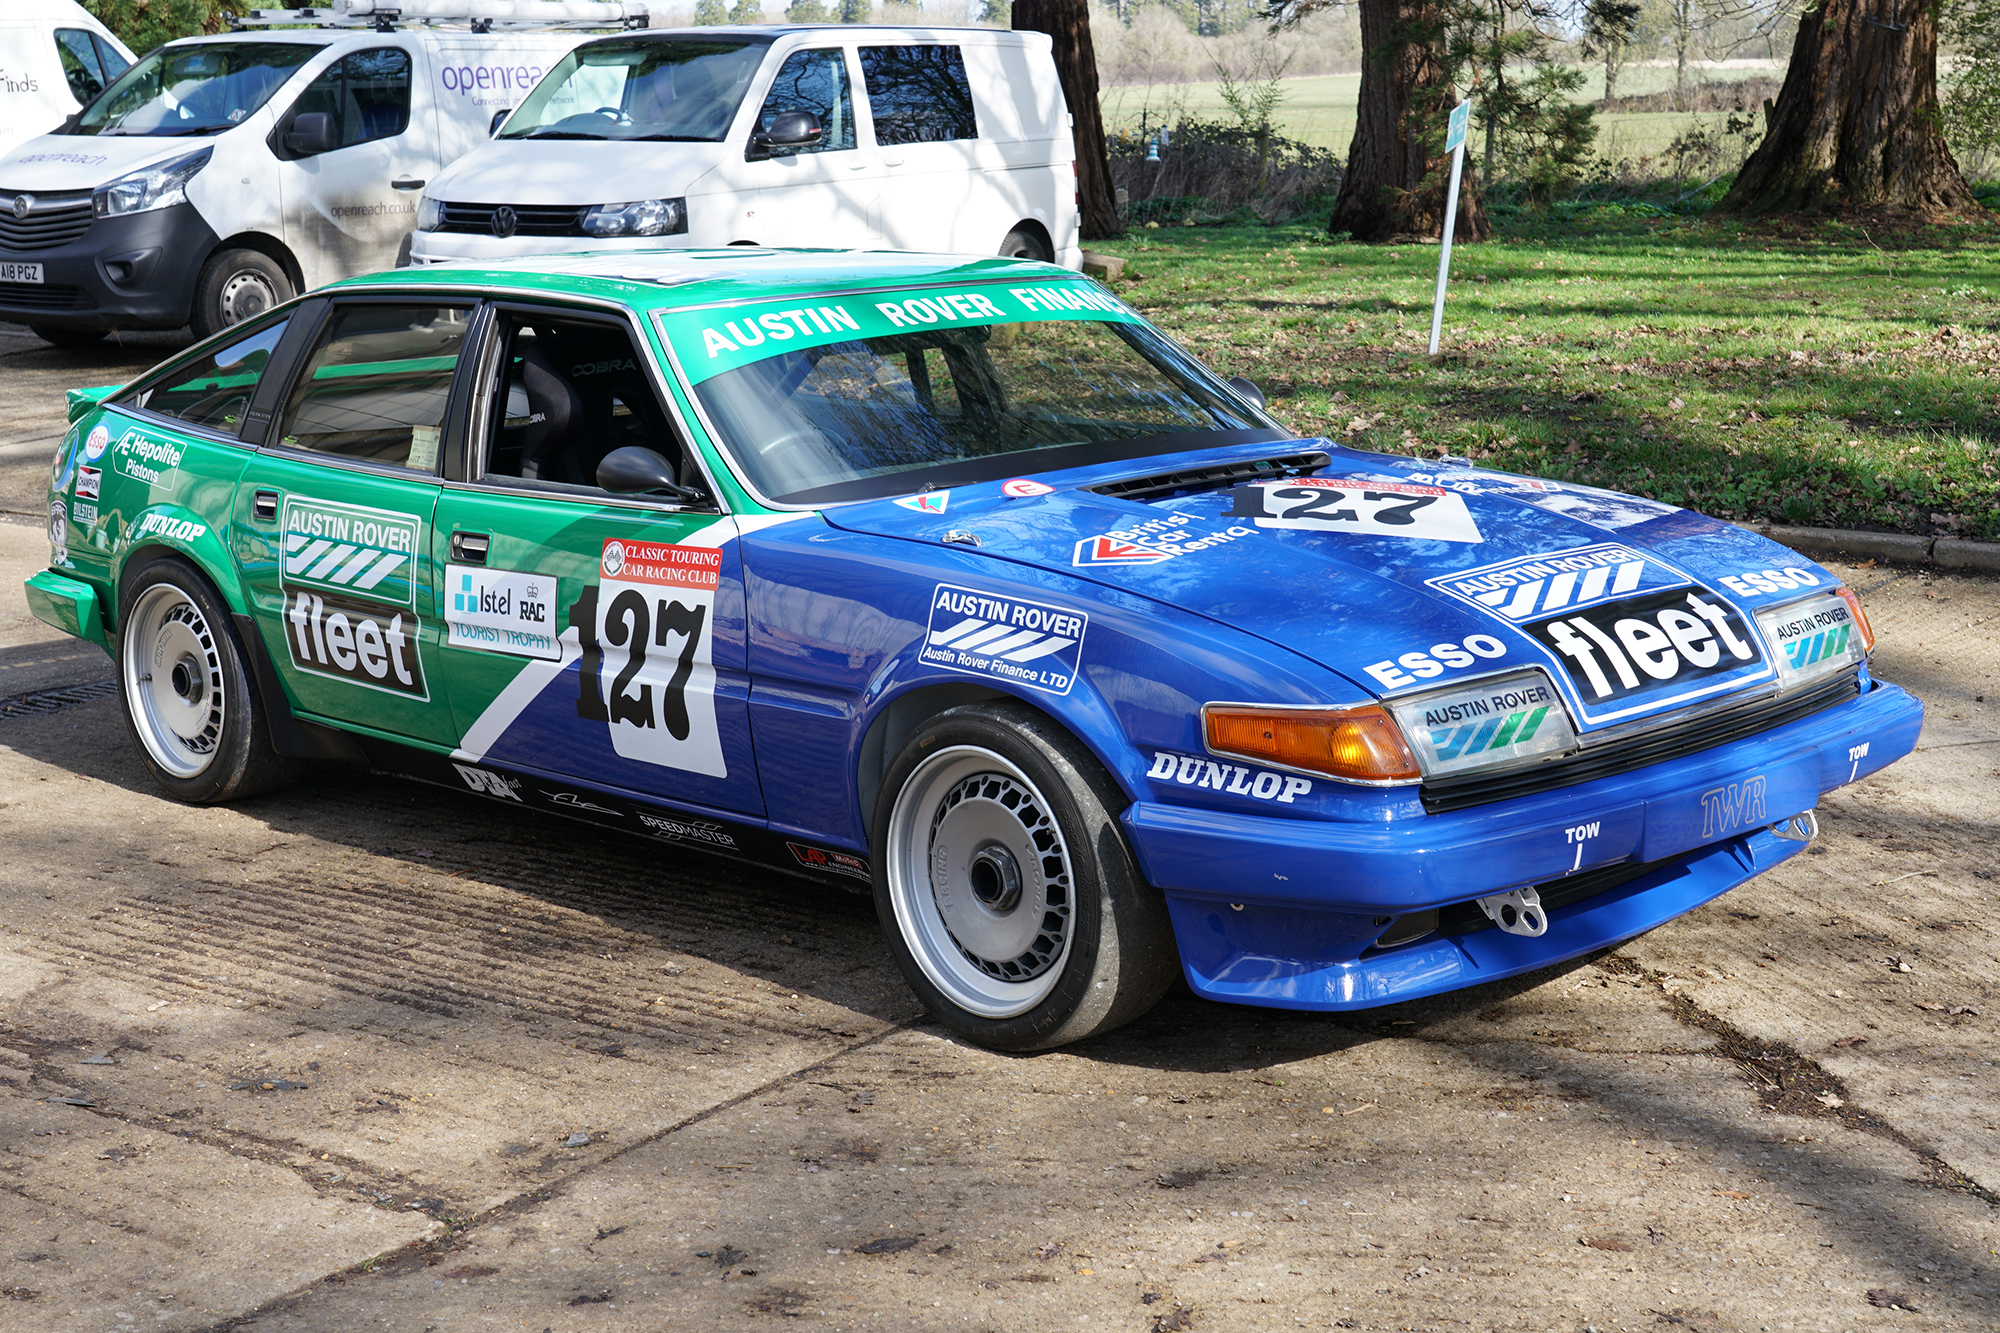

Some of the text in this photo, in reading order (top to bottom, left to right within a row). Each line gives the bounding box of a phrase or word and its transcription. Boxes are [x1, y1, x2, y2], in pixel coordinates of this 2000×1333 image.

[442, 64, 573, 95] openrea
[472, 96, 510, 107] Connecting
[19, 151, 108, 166] openreach
[330, 200, 416, 219] openreach.co.uk
[17, 265, 38, 280] PGZ
[702, 305, 860, 359] AUSTIN
[875, 293, 1007, 327] ROVER
[572, 358, 638, 377] COBRA
[131, 435, 180, 467] Hepolite
[78, 476, 99, 489] CHAMPION
[125, 458, 159, 483] Pistons
[73, 501, 98, 519] BILSTEIN
[1217, 485, 1438, 525] 127
[139, 513, 206, 542] DUNLOP
[288, 510, 411, 552] AUSTIN ROVER
[1135, 529, 1192, 549] Car
[625, 545, 668, 561] CLASSIC
[670, 550, 719, 566] TOURING
[623, 563, 717, 584] CAR RACING CLUB
[1456, 546, 1642, 598] AUSTIN ROVER
[1717, 566, 1820, 598] ESSO
[480, 585, 511, 615] Istel
[519, 601, 545, 622] RAC
[936, 591, 1081, 638] AUSTIN ROVER
[290, 591, 413, 686] fleet
[452, 622, 551, 650] TOURIST TROPHY
[1777, 606, 1849, 641] AUSTIN ROVER
[1545, 592, 1754, 698] fleet
[569, 585, 706, 741] 127
[923, 647, 1068, 688] Austin Rover Finance LTD
[1363, 634, 1507, 690] ESSO
[1425, 685, 1550, 728] AUSTIN ROVER
[1848, 742, 1869, 762] TOW
[1146, 752, 1312, 803] DUNLOP
[1701, 774, 1766, 838] TWR
[639, 815, 736, 846] SPEEDMASTER
[1565, 821, 1600, 844] TOW
[790, 844, 827, 865] LAP
